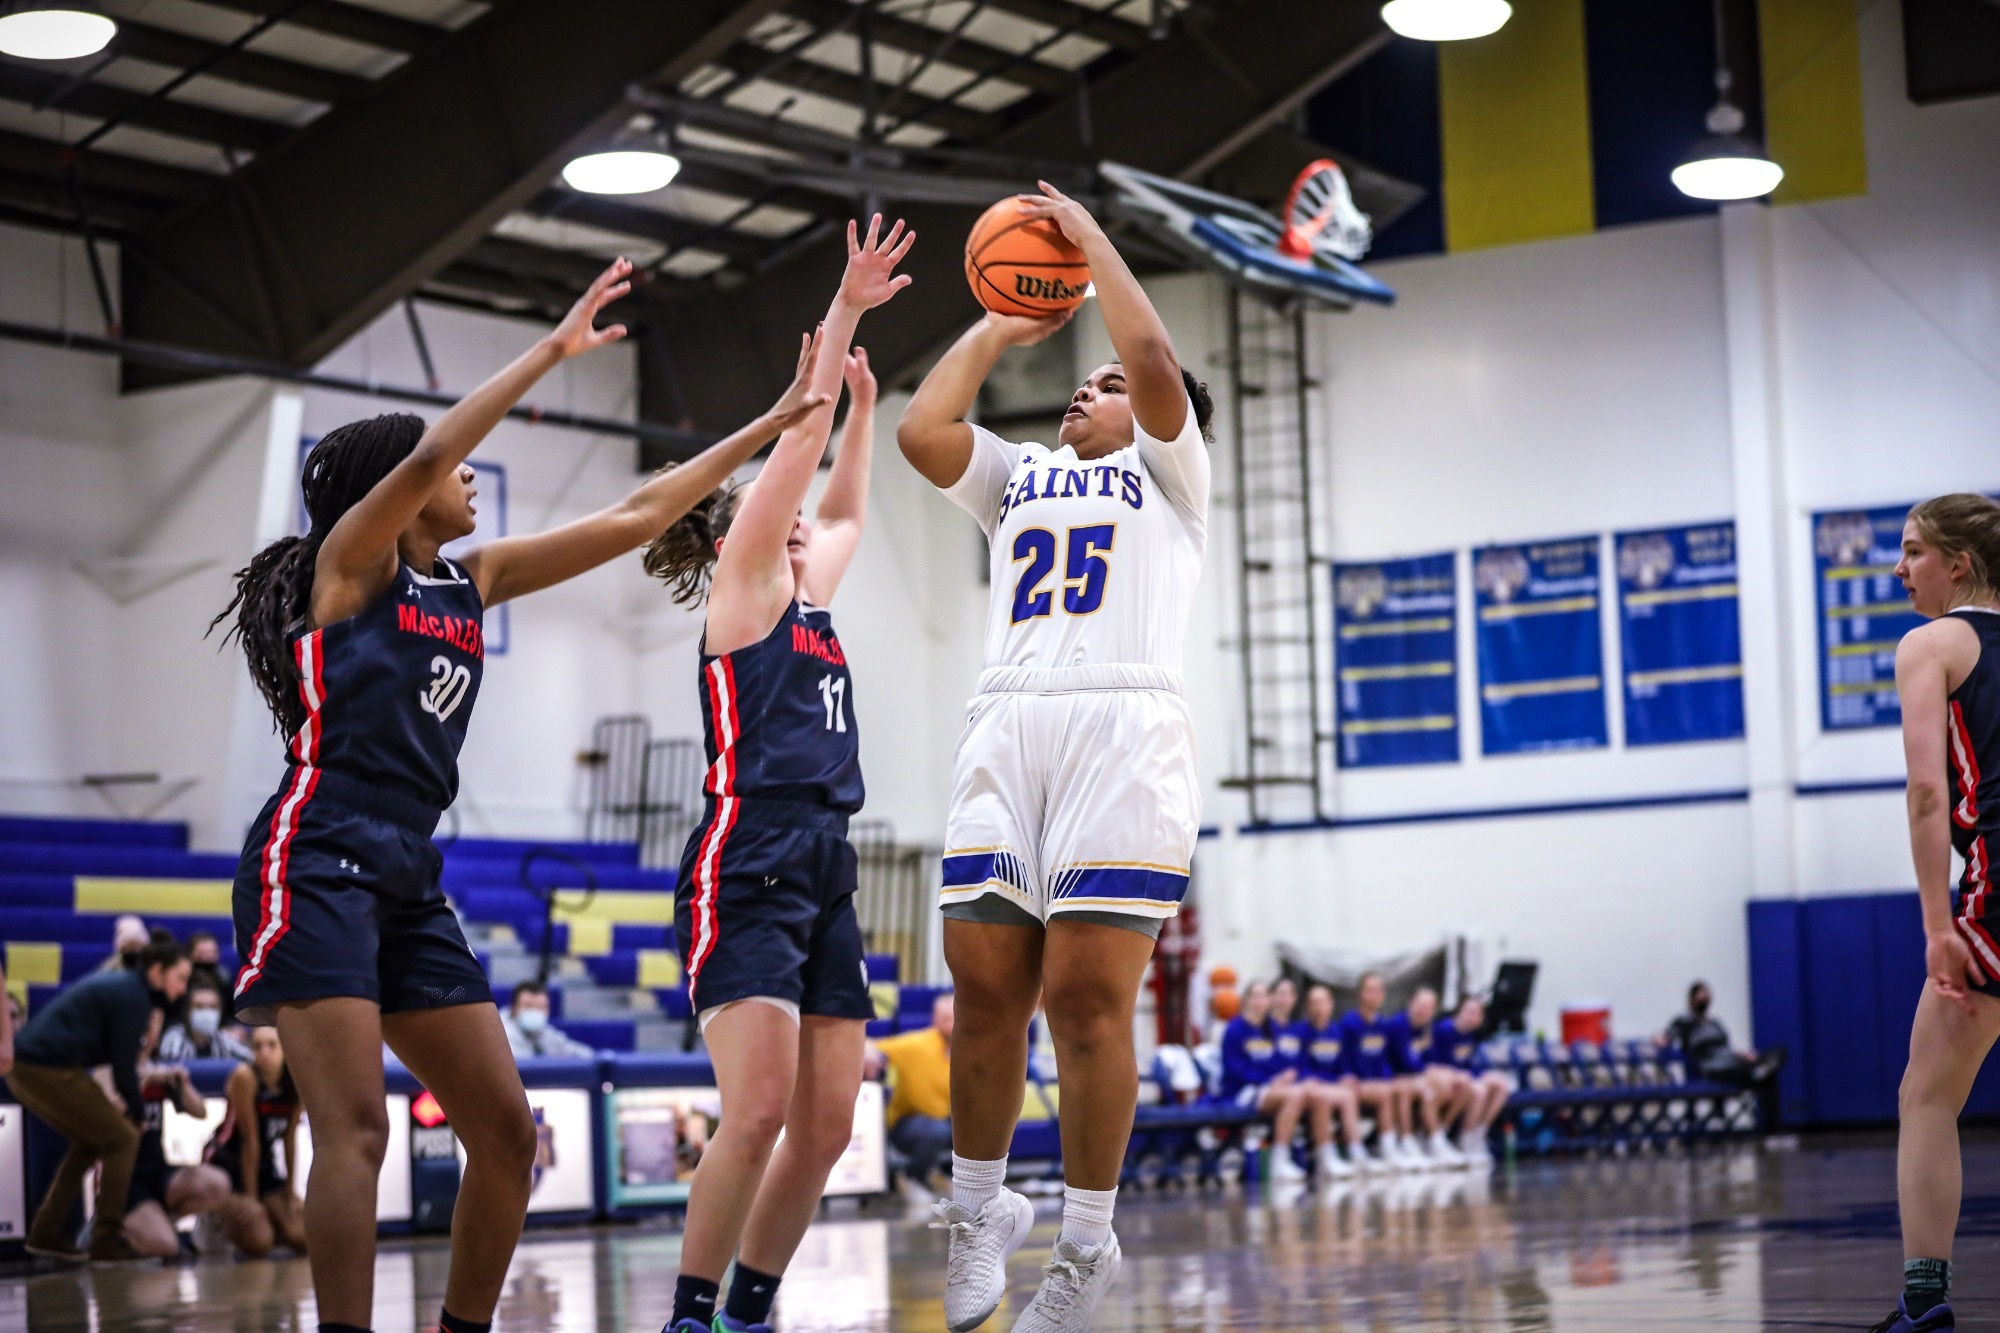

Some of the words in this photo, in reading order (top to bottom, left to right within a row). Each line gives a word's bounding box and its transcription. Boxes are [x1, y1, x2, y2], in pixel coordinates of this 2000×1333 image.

[999, 465, 1144, 527] SAINTS
[1010, 521, 1118, 627] 25
[420, 654, 471, 723] 30
[818, 673, 847, 733] 11
